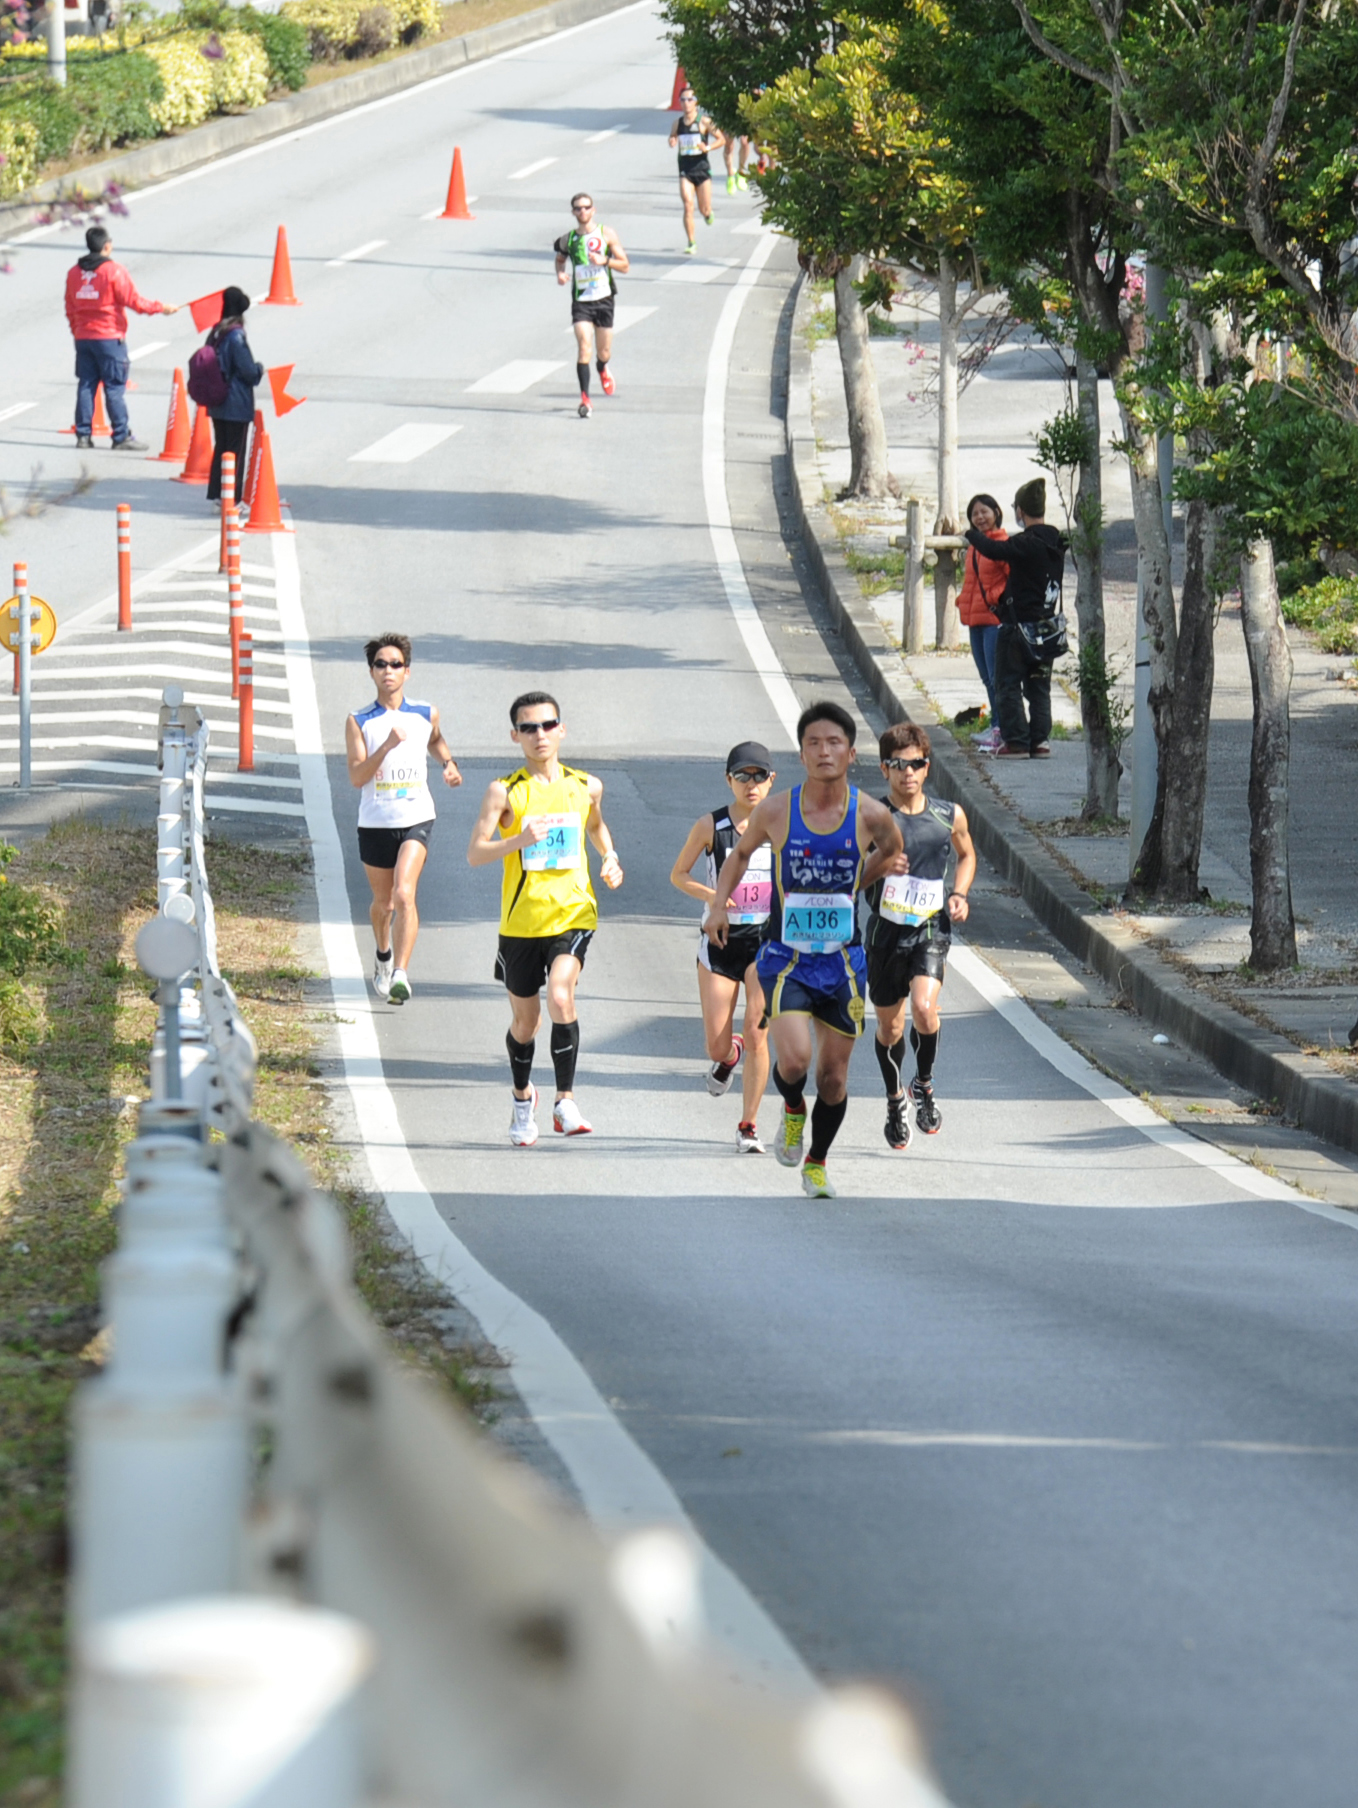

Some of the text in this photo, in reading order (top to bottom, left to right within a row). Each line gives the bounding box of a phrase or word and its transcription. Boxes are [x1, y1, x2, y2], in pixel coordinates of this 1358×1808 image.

[391, 768, 420, 781] 1076
[743, 885, 760, 903] 13
[884, 885, 936, 906] B 1187
[786, 910, 839, 930] A 136
